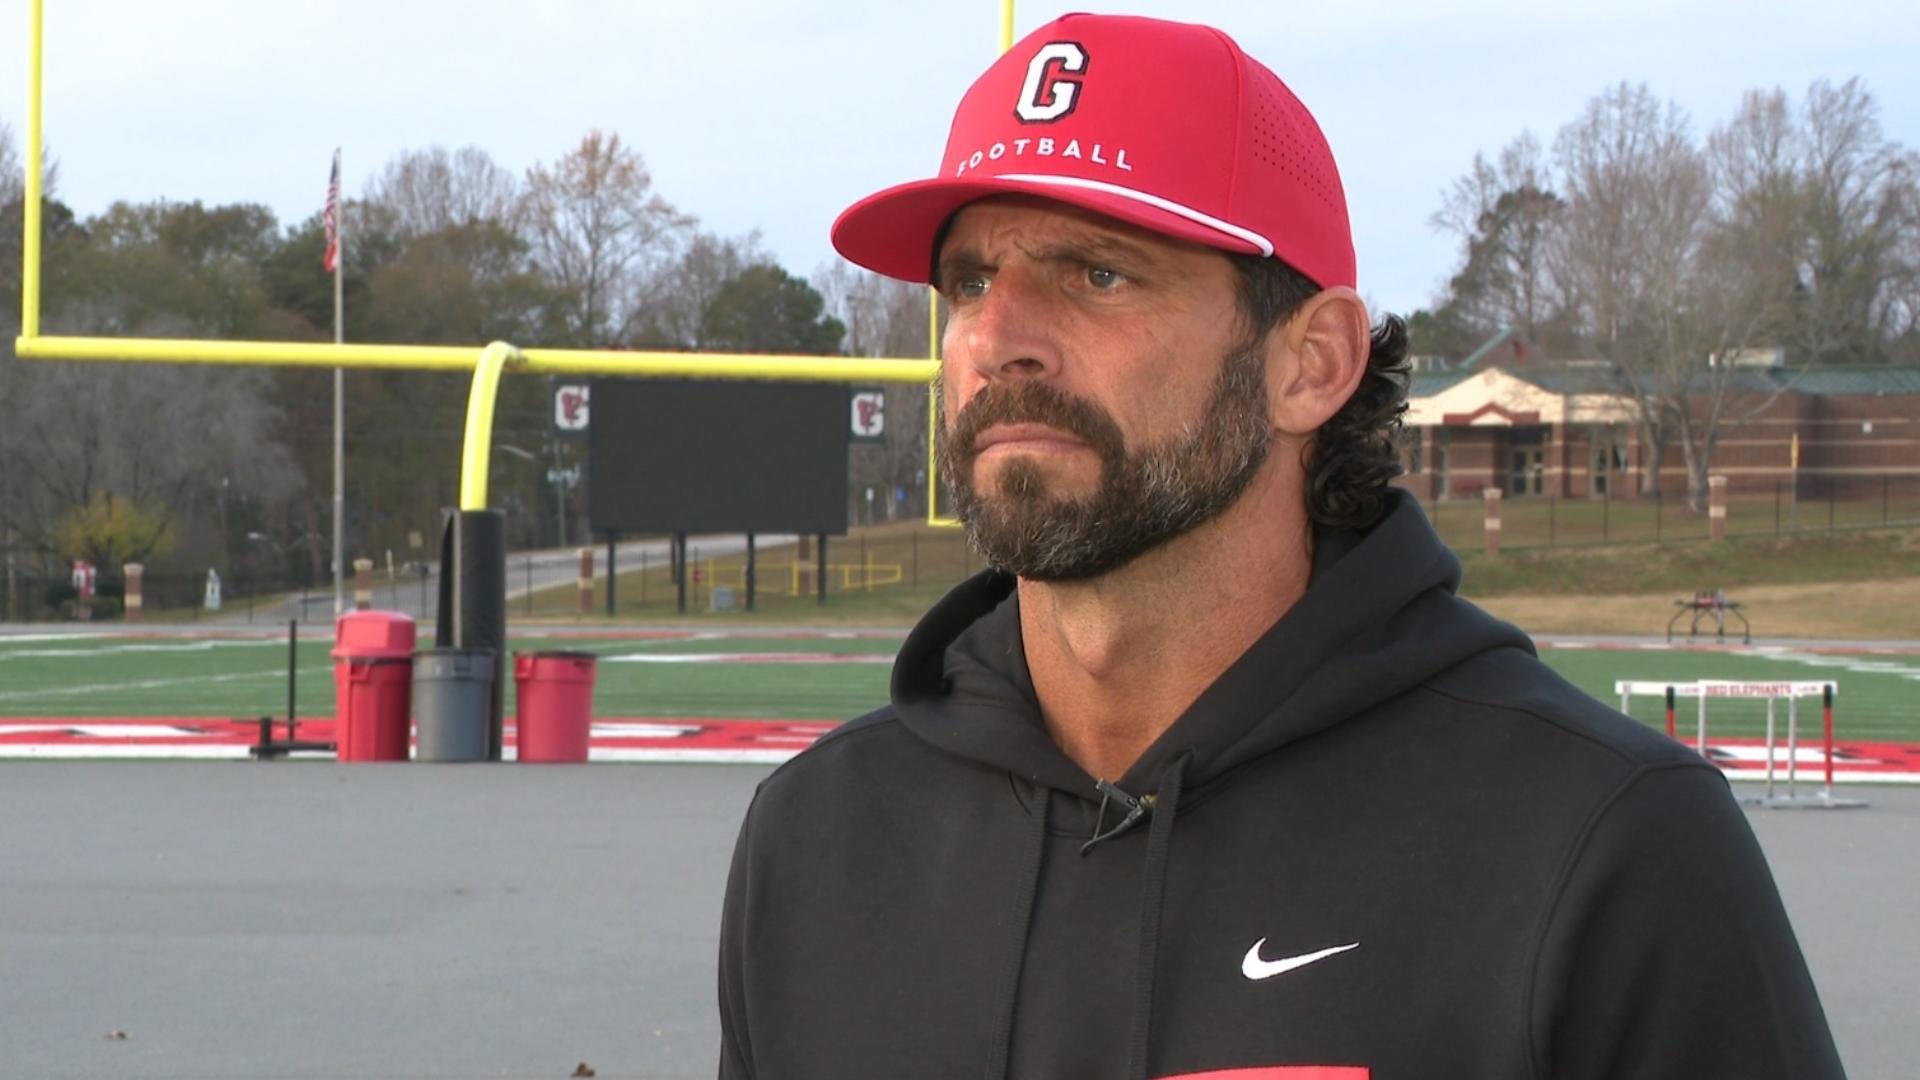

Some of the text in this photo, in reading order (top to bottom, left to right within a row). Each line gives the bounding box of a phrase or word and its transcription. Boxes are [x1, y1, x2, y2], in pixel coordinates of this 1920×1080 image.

[1014, 41, 1090, 124] G
[958, 137, 1132, 177] FOOTBALL
[1706, 684, 1727, 697] RED
[1730, 683, 1792, 697] ELEPHANTS
